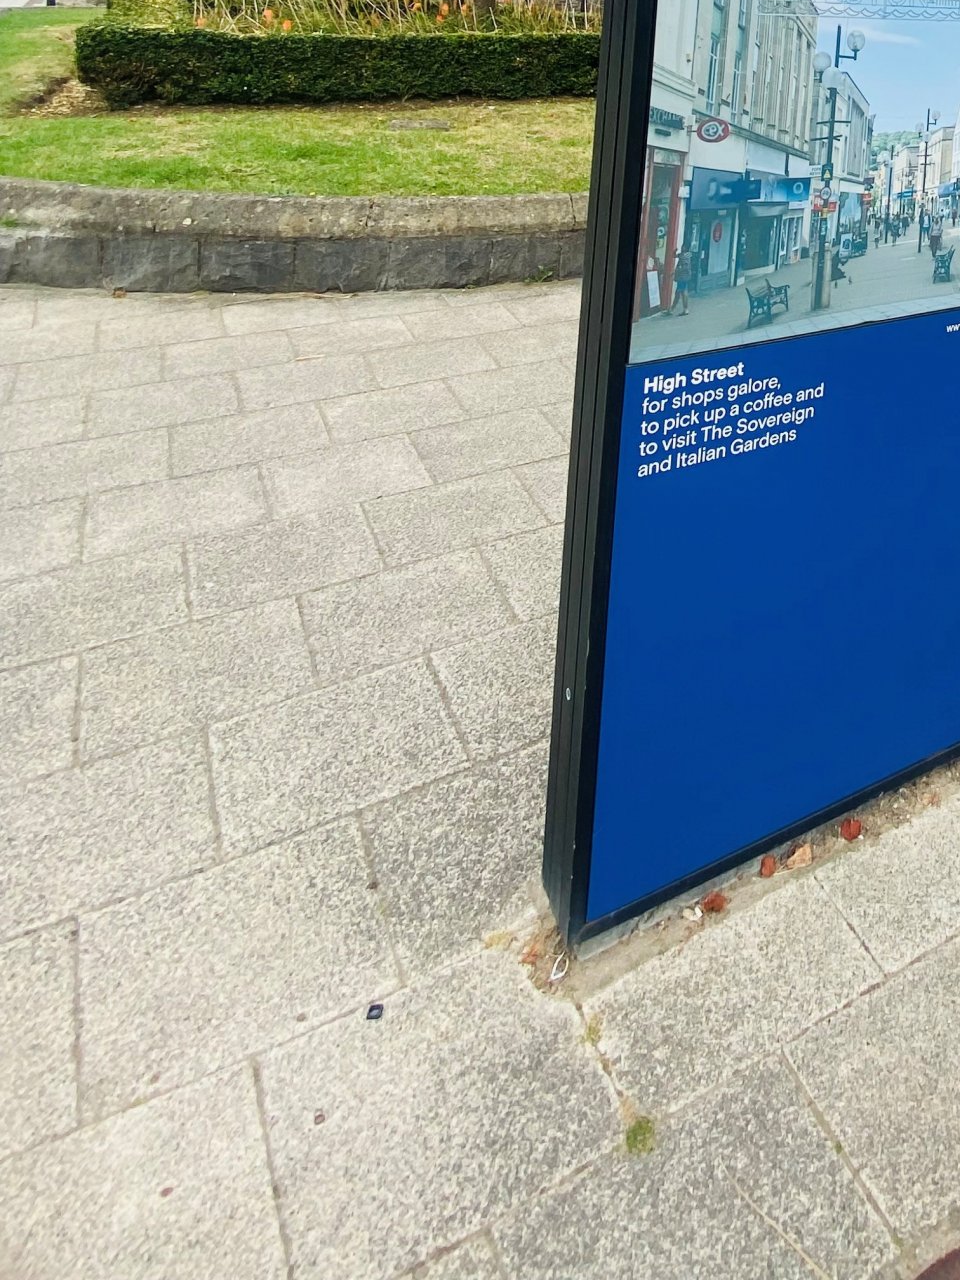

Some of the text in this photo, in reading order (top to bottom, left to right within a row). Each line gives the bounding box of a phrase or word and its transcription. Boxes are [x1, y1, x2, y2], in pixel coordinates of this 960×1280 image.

[641, 376, 782, 415] for shops galore,
[643, 361, 745, 394] High Street
[639, 406, 815, 457] to visit The Sovereign
[640, 382, 825, 436] to pick up a coffee and
[637, 429, 797, 477] and Italian Gardens
